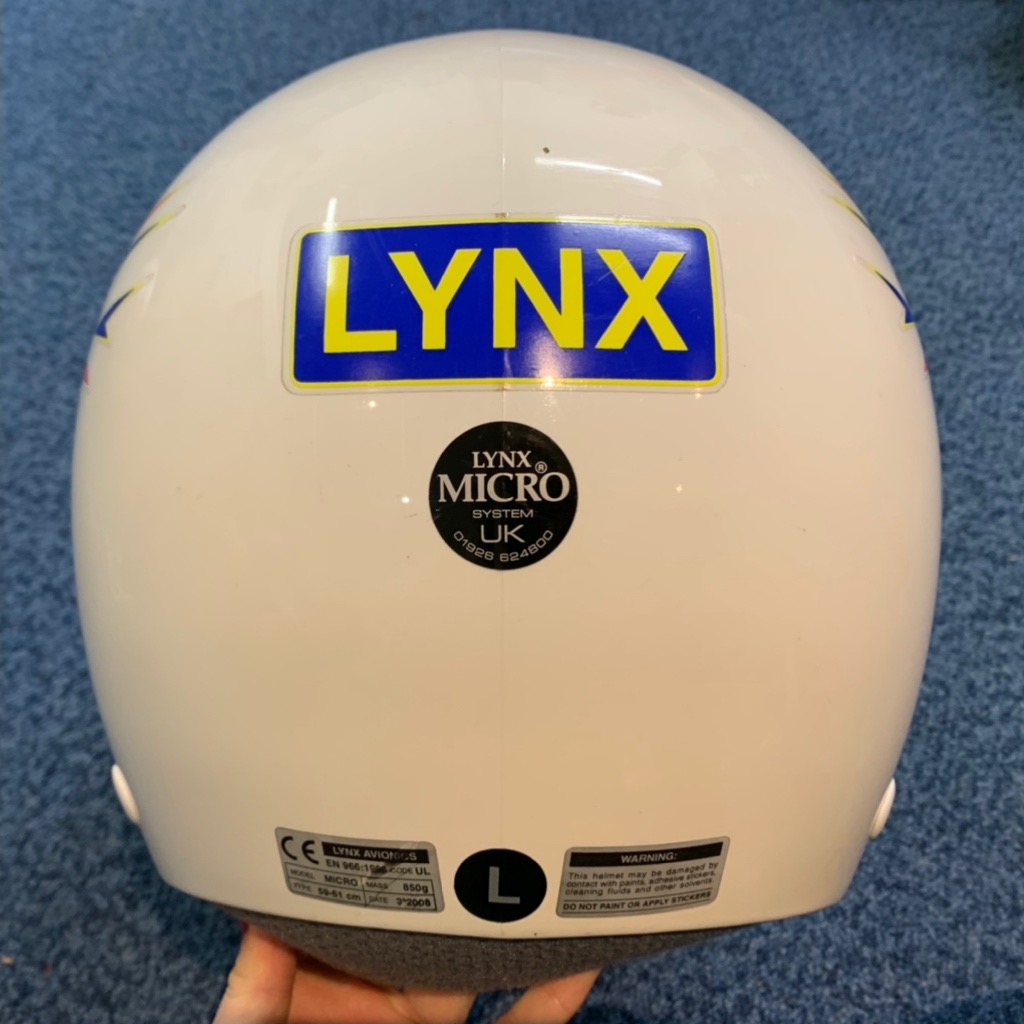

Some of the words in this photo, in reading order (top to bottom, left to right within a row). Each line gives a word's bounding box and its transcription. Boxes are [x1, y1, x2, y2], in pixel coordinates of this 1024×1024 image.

[324, 248, 688, 353] LYNX
[472, 450, 532, 469] LYNX
[437, 472, 570, 503] MICRO
[472, 509, 534, 519] SYSTEM
[480, 524, 526, 543] UK
[453, 530, 494, 561] 01926
[499, 530, 553, 562] 624800
[332, 846, 361, 857] LYNX
[364, 849, 417, 861] AVIONS
[620, 852, 677, 864] WARNING:
[326, 859, 340, 869] EN
[342, 861, 387, 874] 966:19
[415, 866, 431, 876] UL
[569, 871, 587, 880] This
[592, 871, 624, 880] helmet
[628, 871, 647, 879] may
[666, 863, 705, 873] damaged
[708, 862, 719, 870] by
[324, 874, 358, 887] MICRO
[366, 881, 389, 890] MASS
[403, 882, 429, 893] 850g
[488, 866, 520, 904] L
[566, 880, 598, 888] contact
[649, 875, 684, 885] adhesive
[346, 893, 362, 901] cm
[565, 887, 603, 896] cleaning
[607, 887, 631, 895] fluids
[634, 885, 651, 894] and
[654, 883, 677, 892] other
[368, 896, 389, 904] DATE
[563, 902, 577, 911] DO
[578, 902, 598, 911] NOT
[600, 901, 625, 910] PAINT
[627, 900, 640, 909] OR
[642, 898, 669, 907] APPLY
[671, 891, 711, 903] STICKERS
